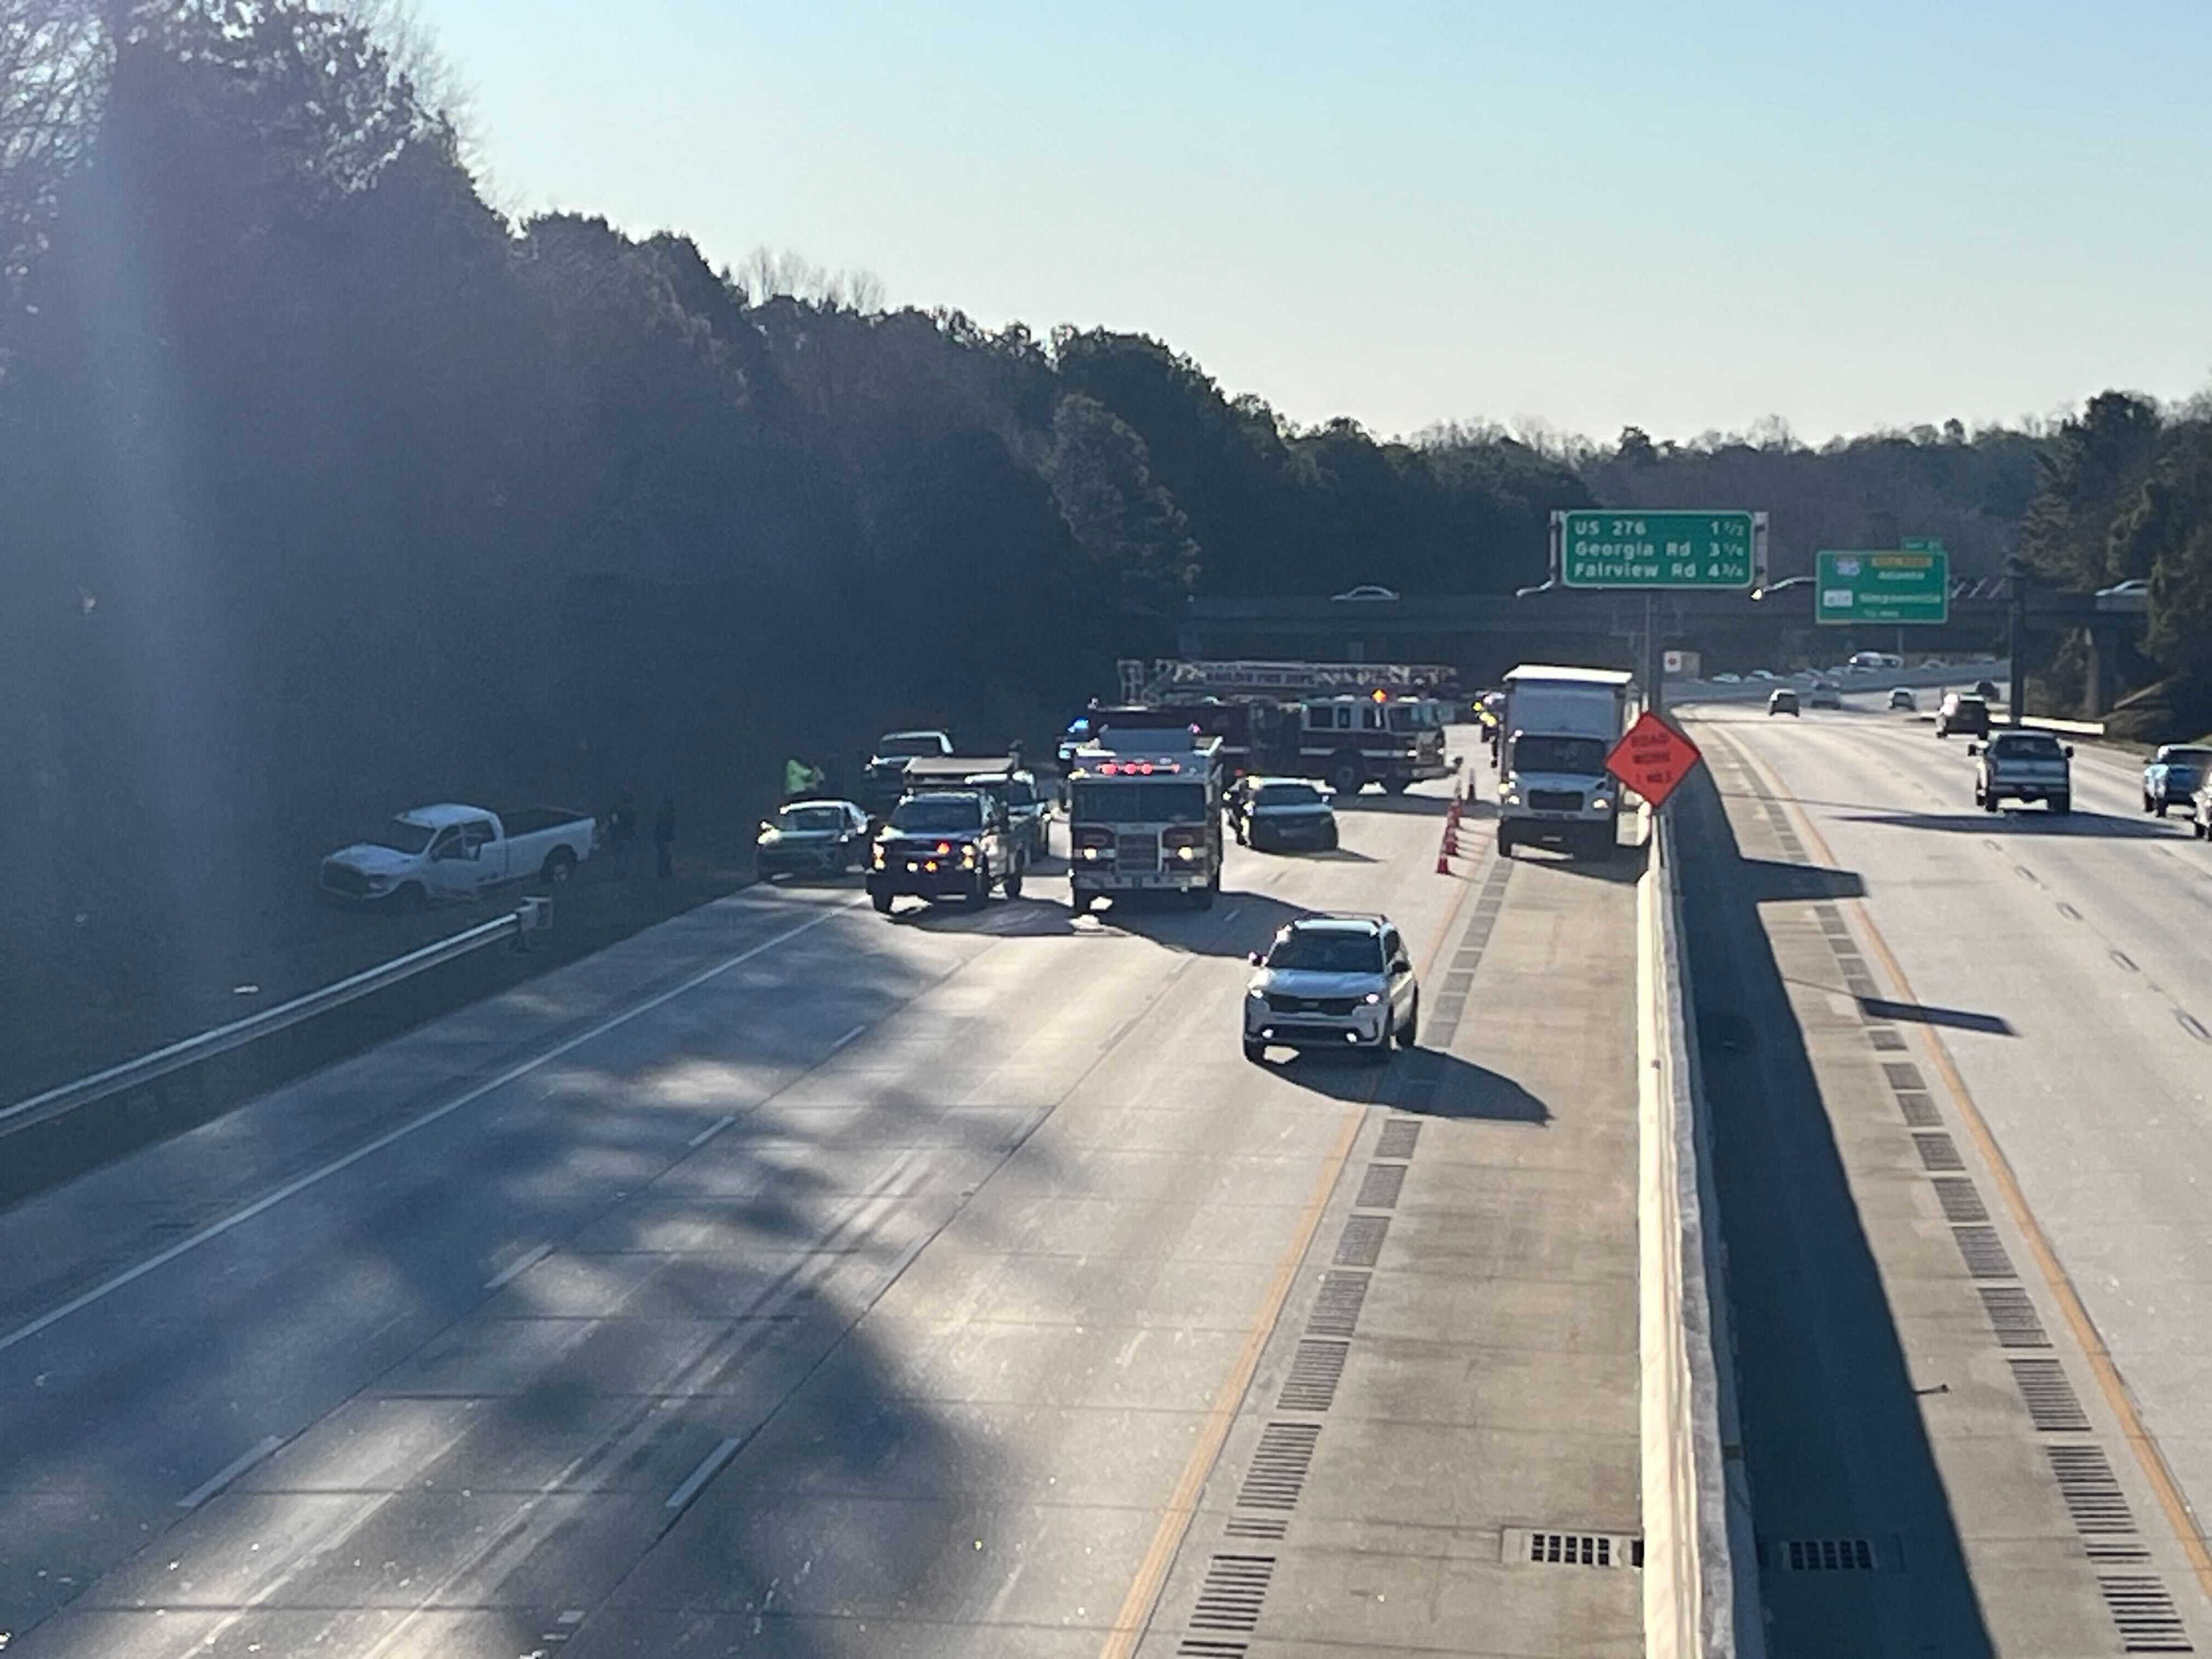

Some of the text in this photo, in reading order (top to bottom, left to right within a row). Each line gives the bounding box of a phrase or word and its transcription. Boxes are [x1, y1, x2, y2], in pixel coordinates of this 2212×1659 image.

[1575, 521, 1599, 536] US
[1612, 521, 1646, 536] 276
[1575, 541, 1654, 560] Georgia
[1666, 541, 1690, 556] Rd
[1574, 561, 1659, 578] Fairview
[1671, 562, 1696, 578] Rd
